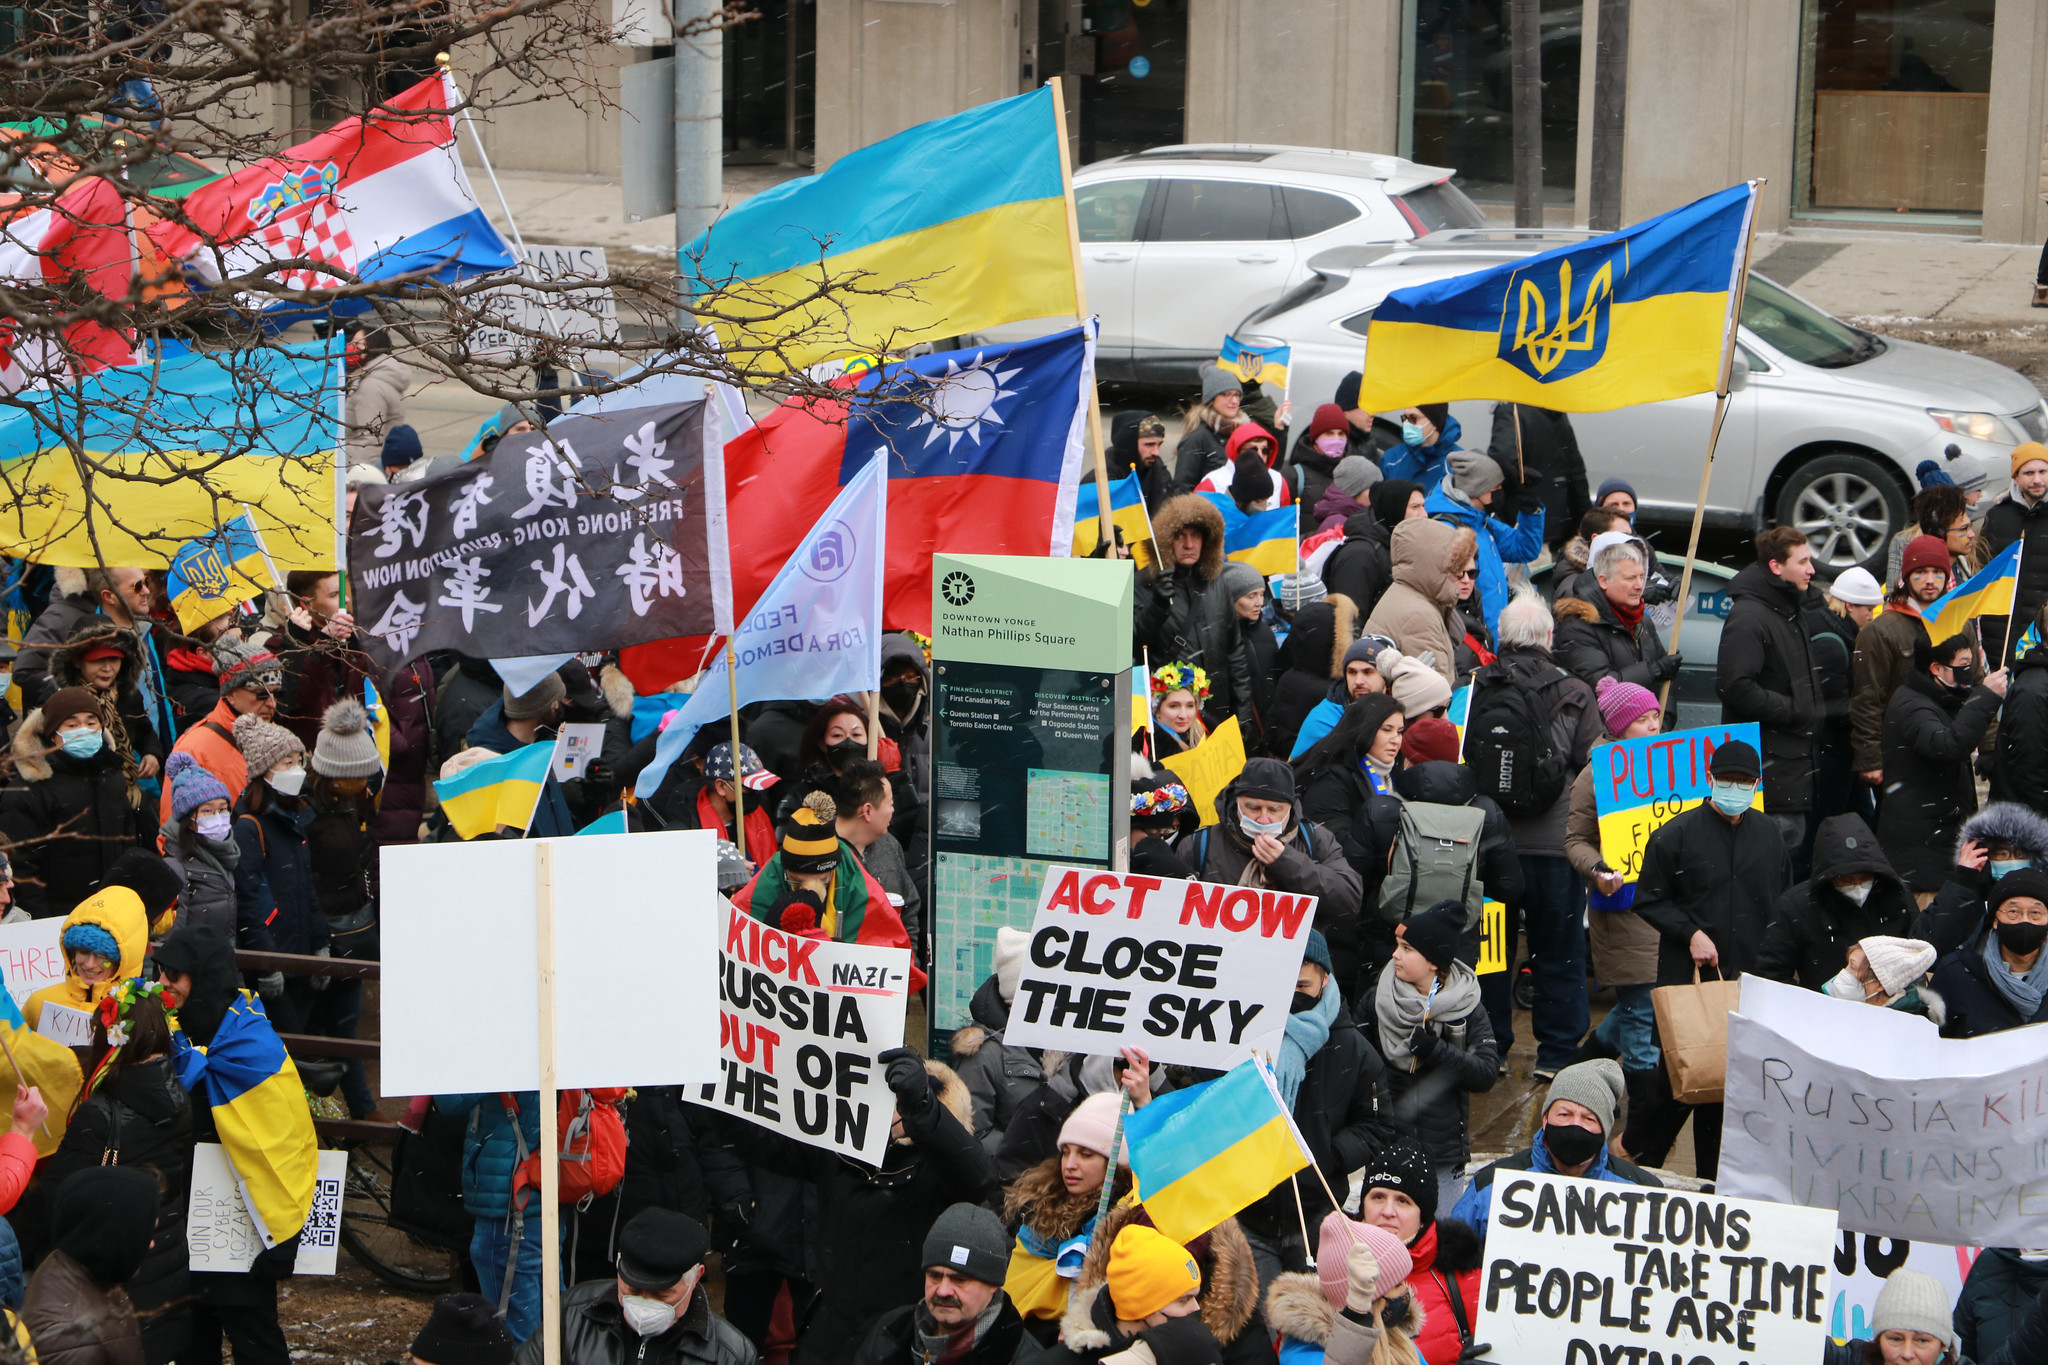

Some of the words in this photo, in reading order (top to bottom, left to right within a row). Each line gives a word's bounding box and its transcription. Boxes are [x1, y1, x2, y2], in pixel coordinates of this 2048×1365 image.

[942, 613, 1000, 624] DOWNTOWN
[1004, 618, 1036, 627] YONGE
[942, 625, 984, 638] Nathan
[988, 628, 1031, 643] Phillips
[1035, 632, 1076, 646] Square
[950, 686, 983, 694] FINANCIAL
[964, 696, 992, 704] Canadian
[994, 698, 1010, 706] Place
[1034, 692, 1069, 700] DISCOVERY
[1053, 703, 1078, 711] Seasons
[950, 710, 970, 718] Queen
[970, 712, 992, 720] Station
[950, 720, 973, 728] Toronto
[1051, 710, 1085, 720] Performing
[1062, 731, 1082, 739] Queen
[1499, 750, 1514, 789] ROOTS
[1652, 793, 1683, 818] GO
[1047, 870, 1162, 919] ACT
[1179, 883, 1312, 940] NOW
[726, 907, 821, 987] KICK
[1030, 926, 1223, 989] CLOSE
[1020, 979, 1131, 1033] THE
[1143, 993, 1264, 1045] SKY
[796, 1044, 871, 1098] OF
[793, 1089, 869, 1151] UN
[193, 1186, 214, 1218] OUR
[1498, 1180, 1751, 1251] SANCTIONS
[213, 1195, 232, 1249] CYBER
[230, 1205, 248, 1261] KOZAK
[190, 1226, 211, 1263] JOIN
[1613, 1243, 1710, 1300] TAKE
[1720, 1255, 1826, 1324] TIME
[1485, 1259, 1653, 1333] PEOPLE
[1666, 1296, 1756, 1351] ARE
